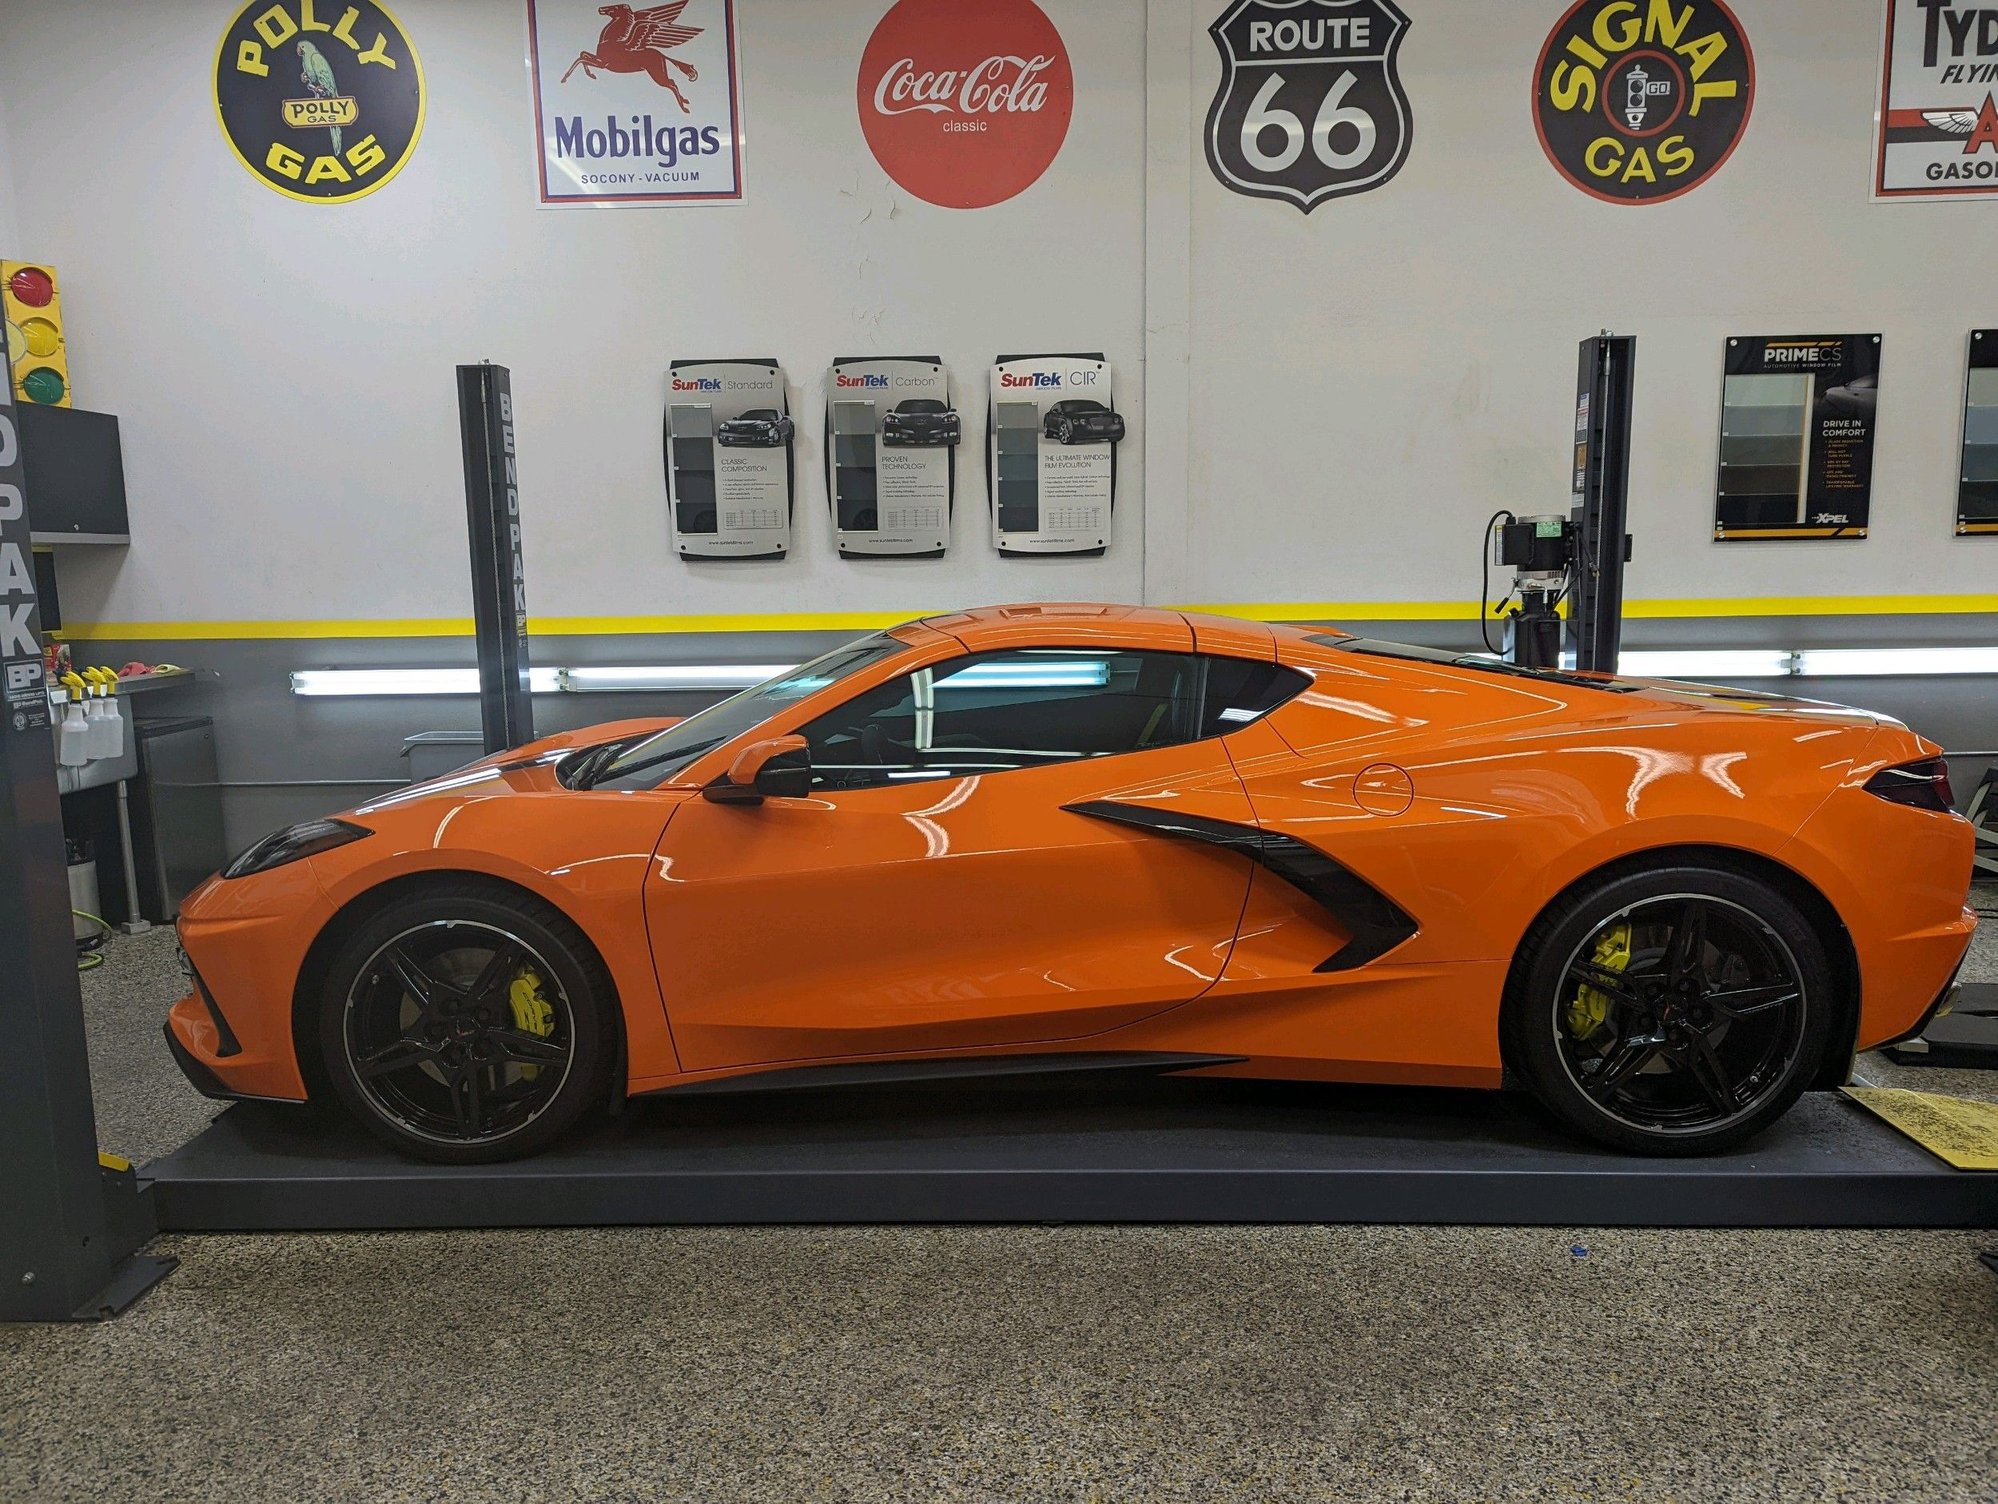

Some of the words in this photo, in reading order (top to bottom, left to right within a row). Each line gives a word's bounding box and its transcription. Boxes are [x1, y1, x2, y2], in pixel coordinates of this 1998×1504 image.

[236, 0, 396, 77] POLLY
[1249, 17, 1371, 52] ROUTE
[1550, 0, 1738, 117] SIGNAL
[290, 100, 350, 119] POLLY
[307, 115, 337, 124] GAS
[942, 119, 988, 133] classic
[1240, 69, 1377, 172] 66
[555, 115, 720, 168] Mobilgas
[266, 134, 386, 185] GAS
[1584, 135, 1695, 184] GAS
[1925, 161, 1998, 181] GASO
[672, 378, 722, 391] SunTek
[727, 379, 773, 391] Standard
[836, 374, 889, 388] SunTek
[1000, 372, 1062, 388] SunTek
[1822, 428, 1866, 437] COMFORT
[1823, 420, 1850, 428] DRIVE
[1852, 420, 1862, 428] IN
[500, 392, 526, 611] BENDPAK
[1815, 512, 1849, 524] XPEL
[7, 663, 41, 690] BP
